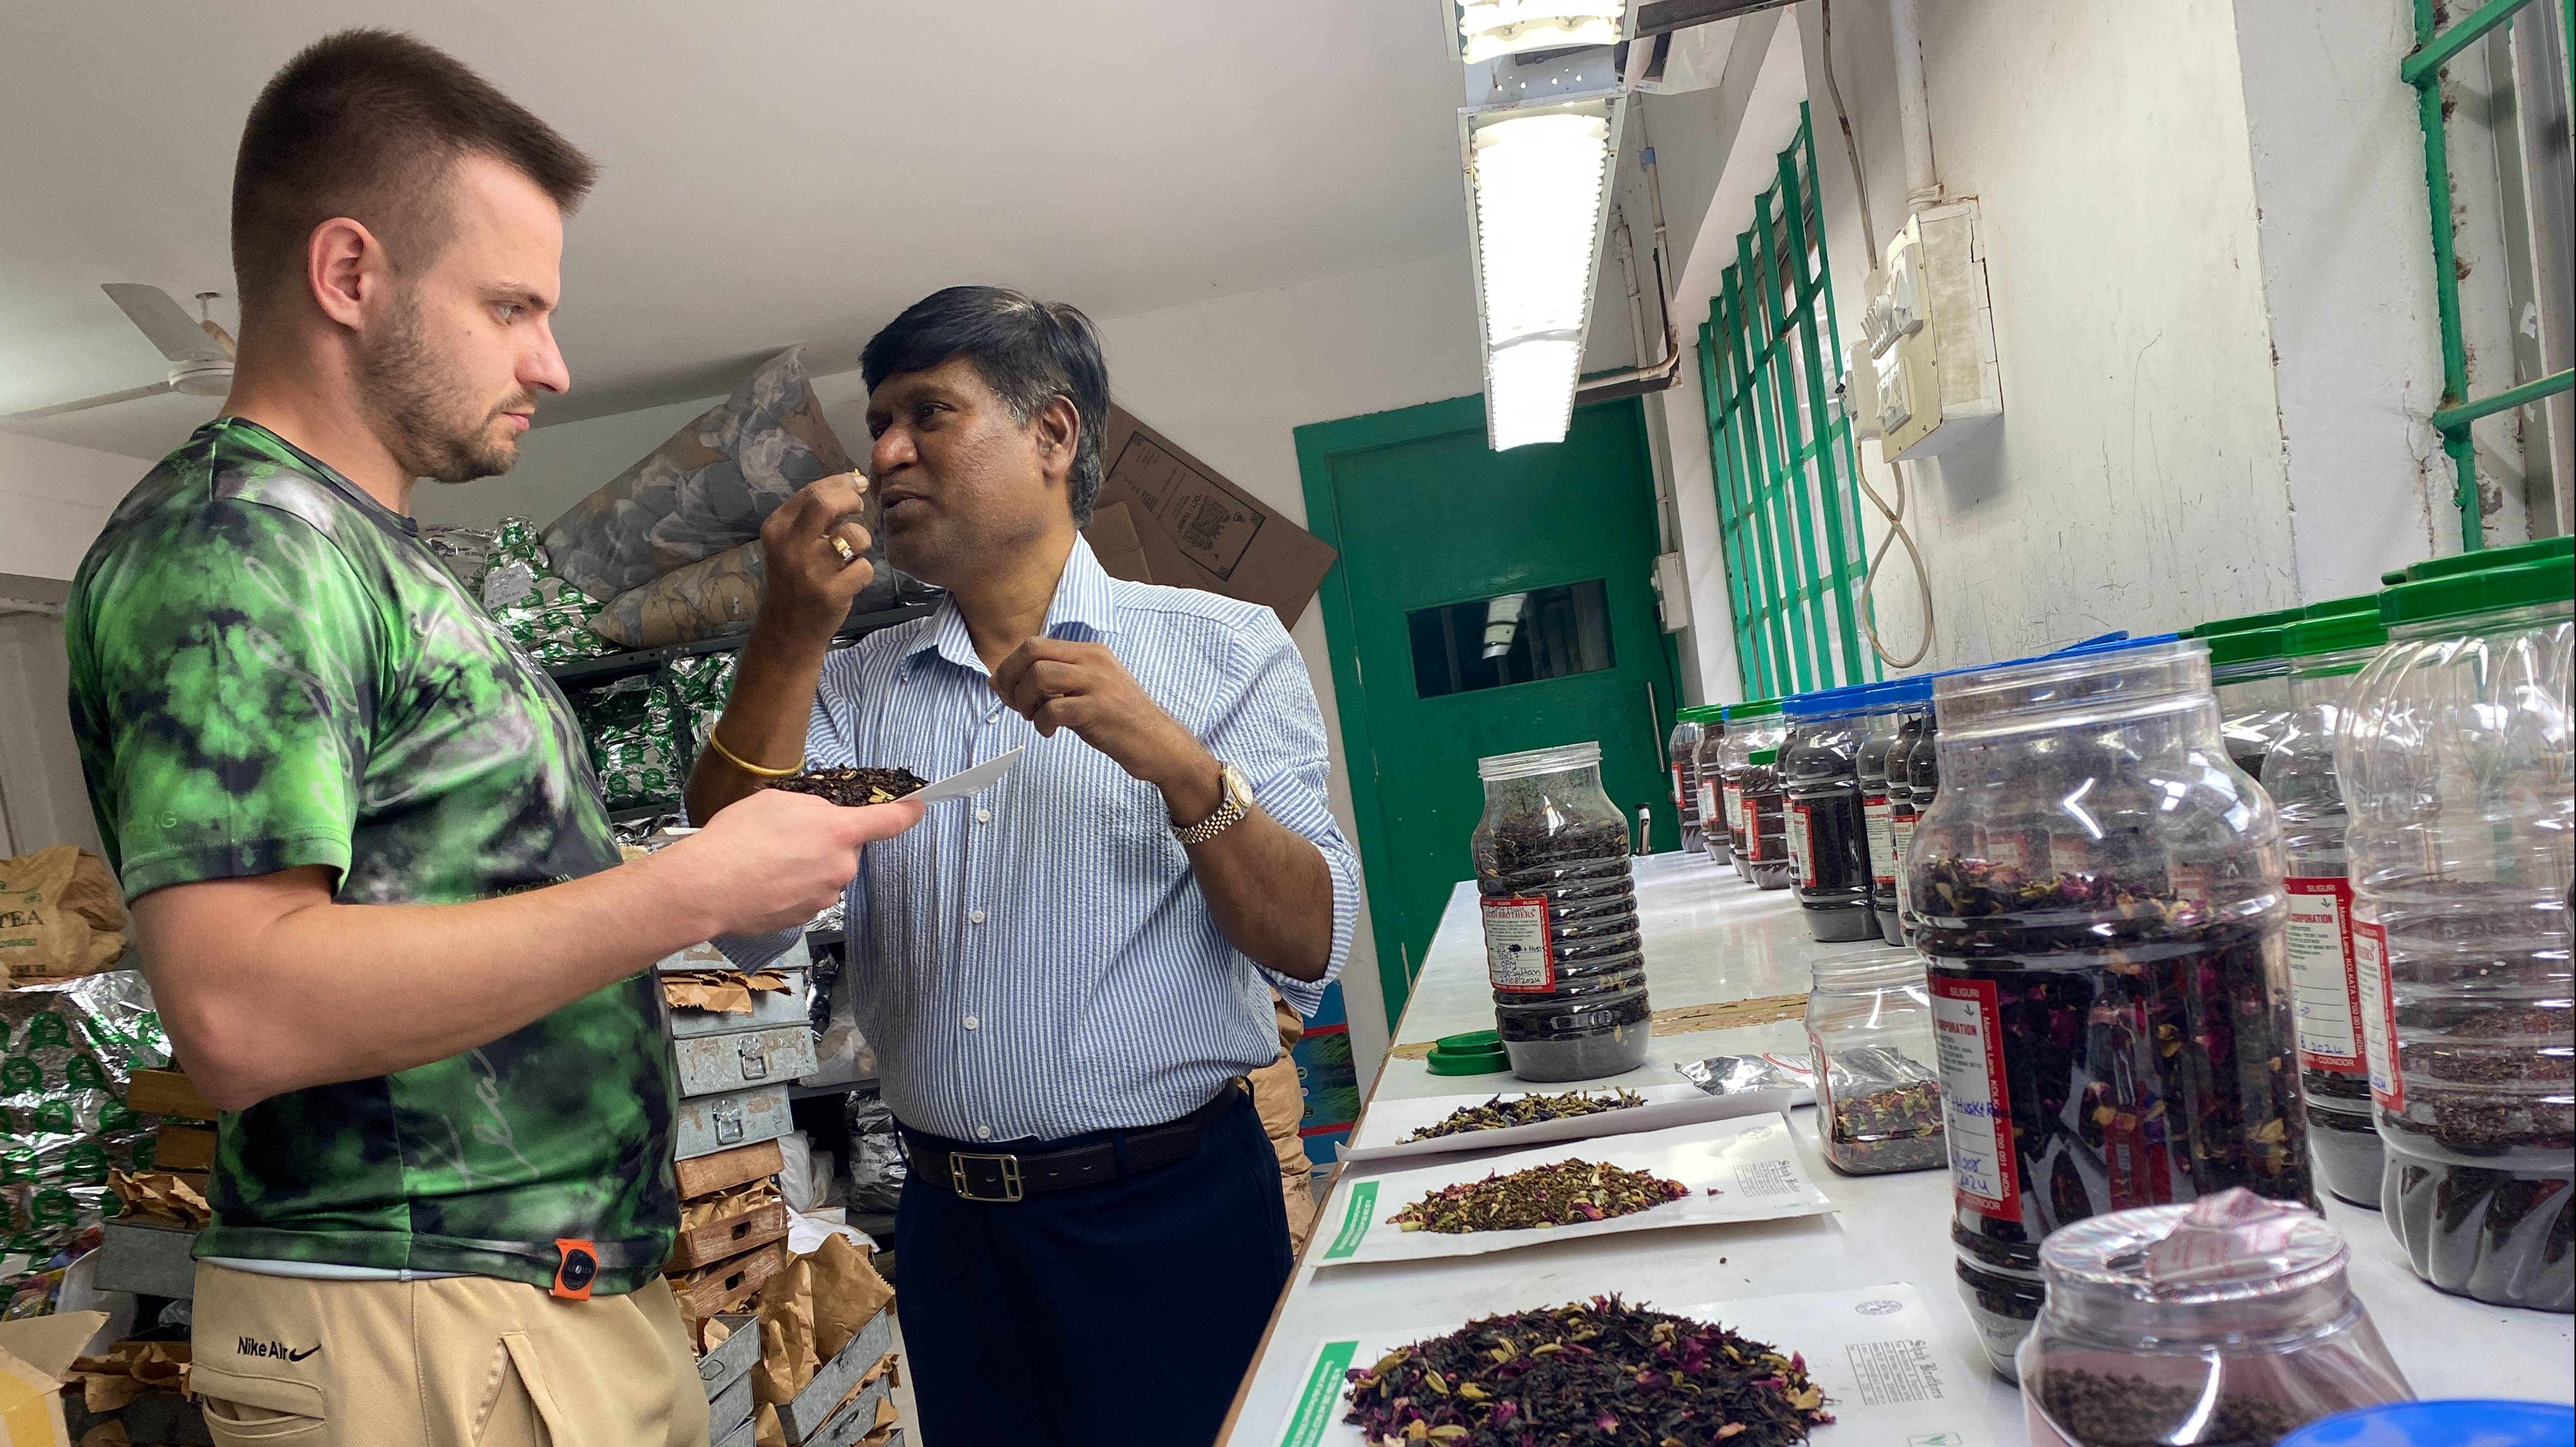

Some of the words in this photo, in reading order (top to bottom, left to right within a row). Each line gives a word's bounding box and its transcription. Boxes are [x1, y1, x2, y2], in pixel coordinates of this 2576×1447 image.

[2345, 958, 2357, 995] KOLKATA
[2355, 1033, 2364, 1055] INDIA
[1996, 1132, 2006, 1149] 700
[2002, 1172, 2011, 1198] INDIA
[237, 1336, 267, 1357] Nike
[268, 1341, 288, 1361] Air
